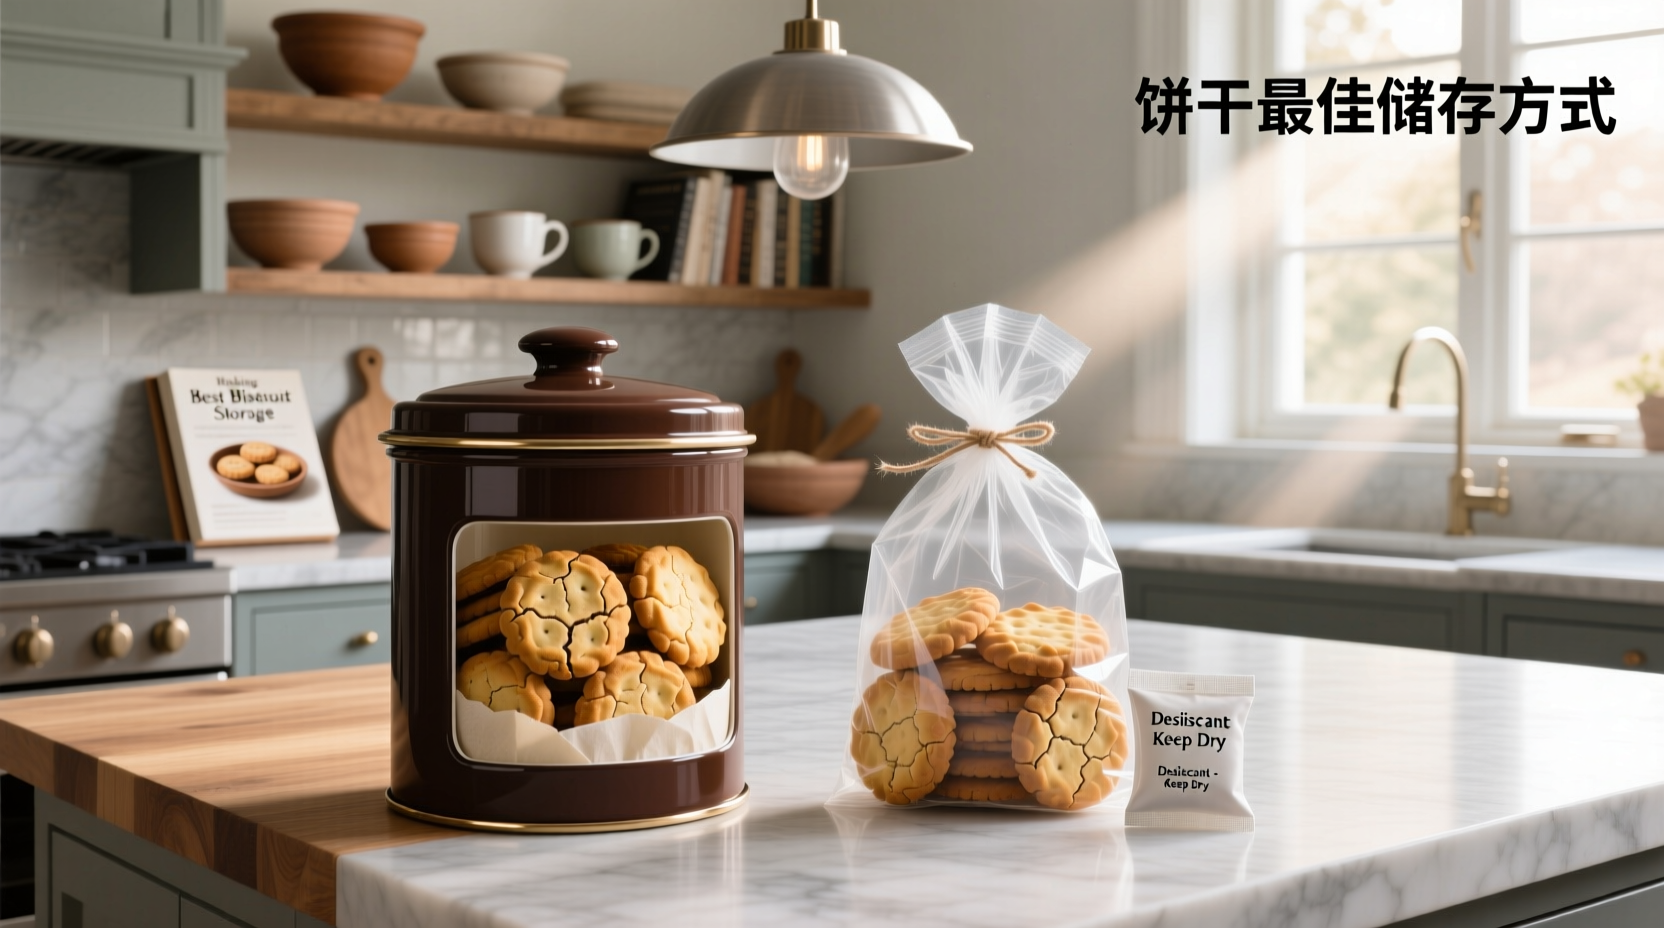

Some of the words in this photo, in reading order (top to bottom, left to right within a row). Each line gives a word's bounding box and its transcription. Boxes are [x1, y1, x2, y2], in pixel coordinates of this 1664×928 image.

[1153, 731, 1192, 751] Keep
[1197, 732, 1227, 753] Dry
[1191, 779, 1210, 793] Dry
